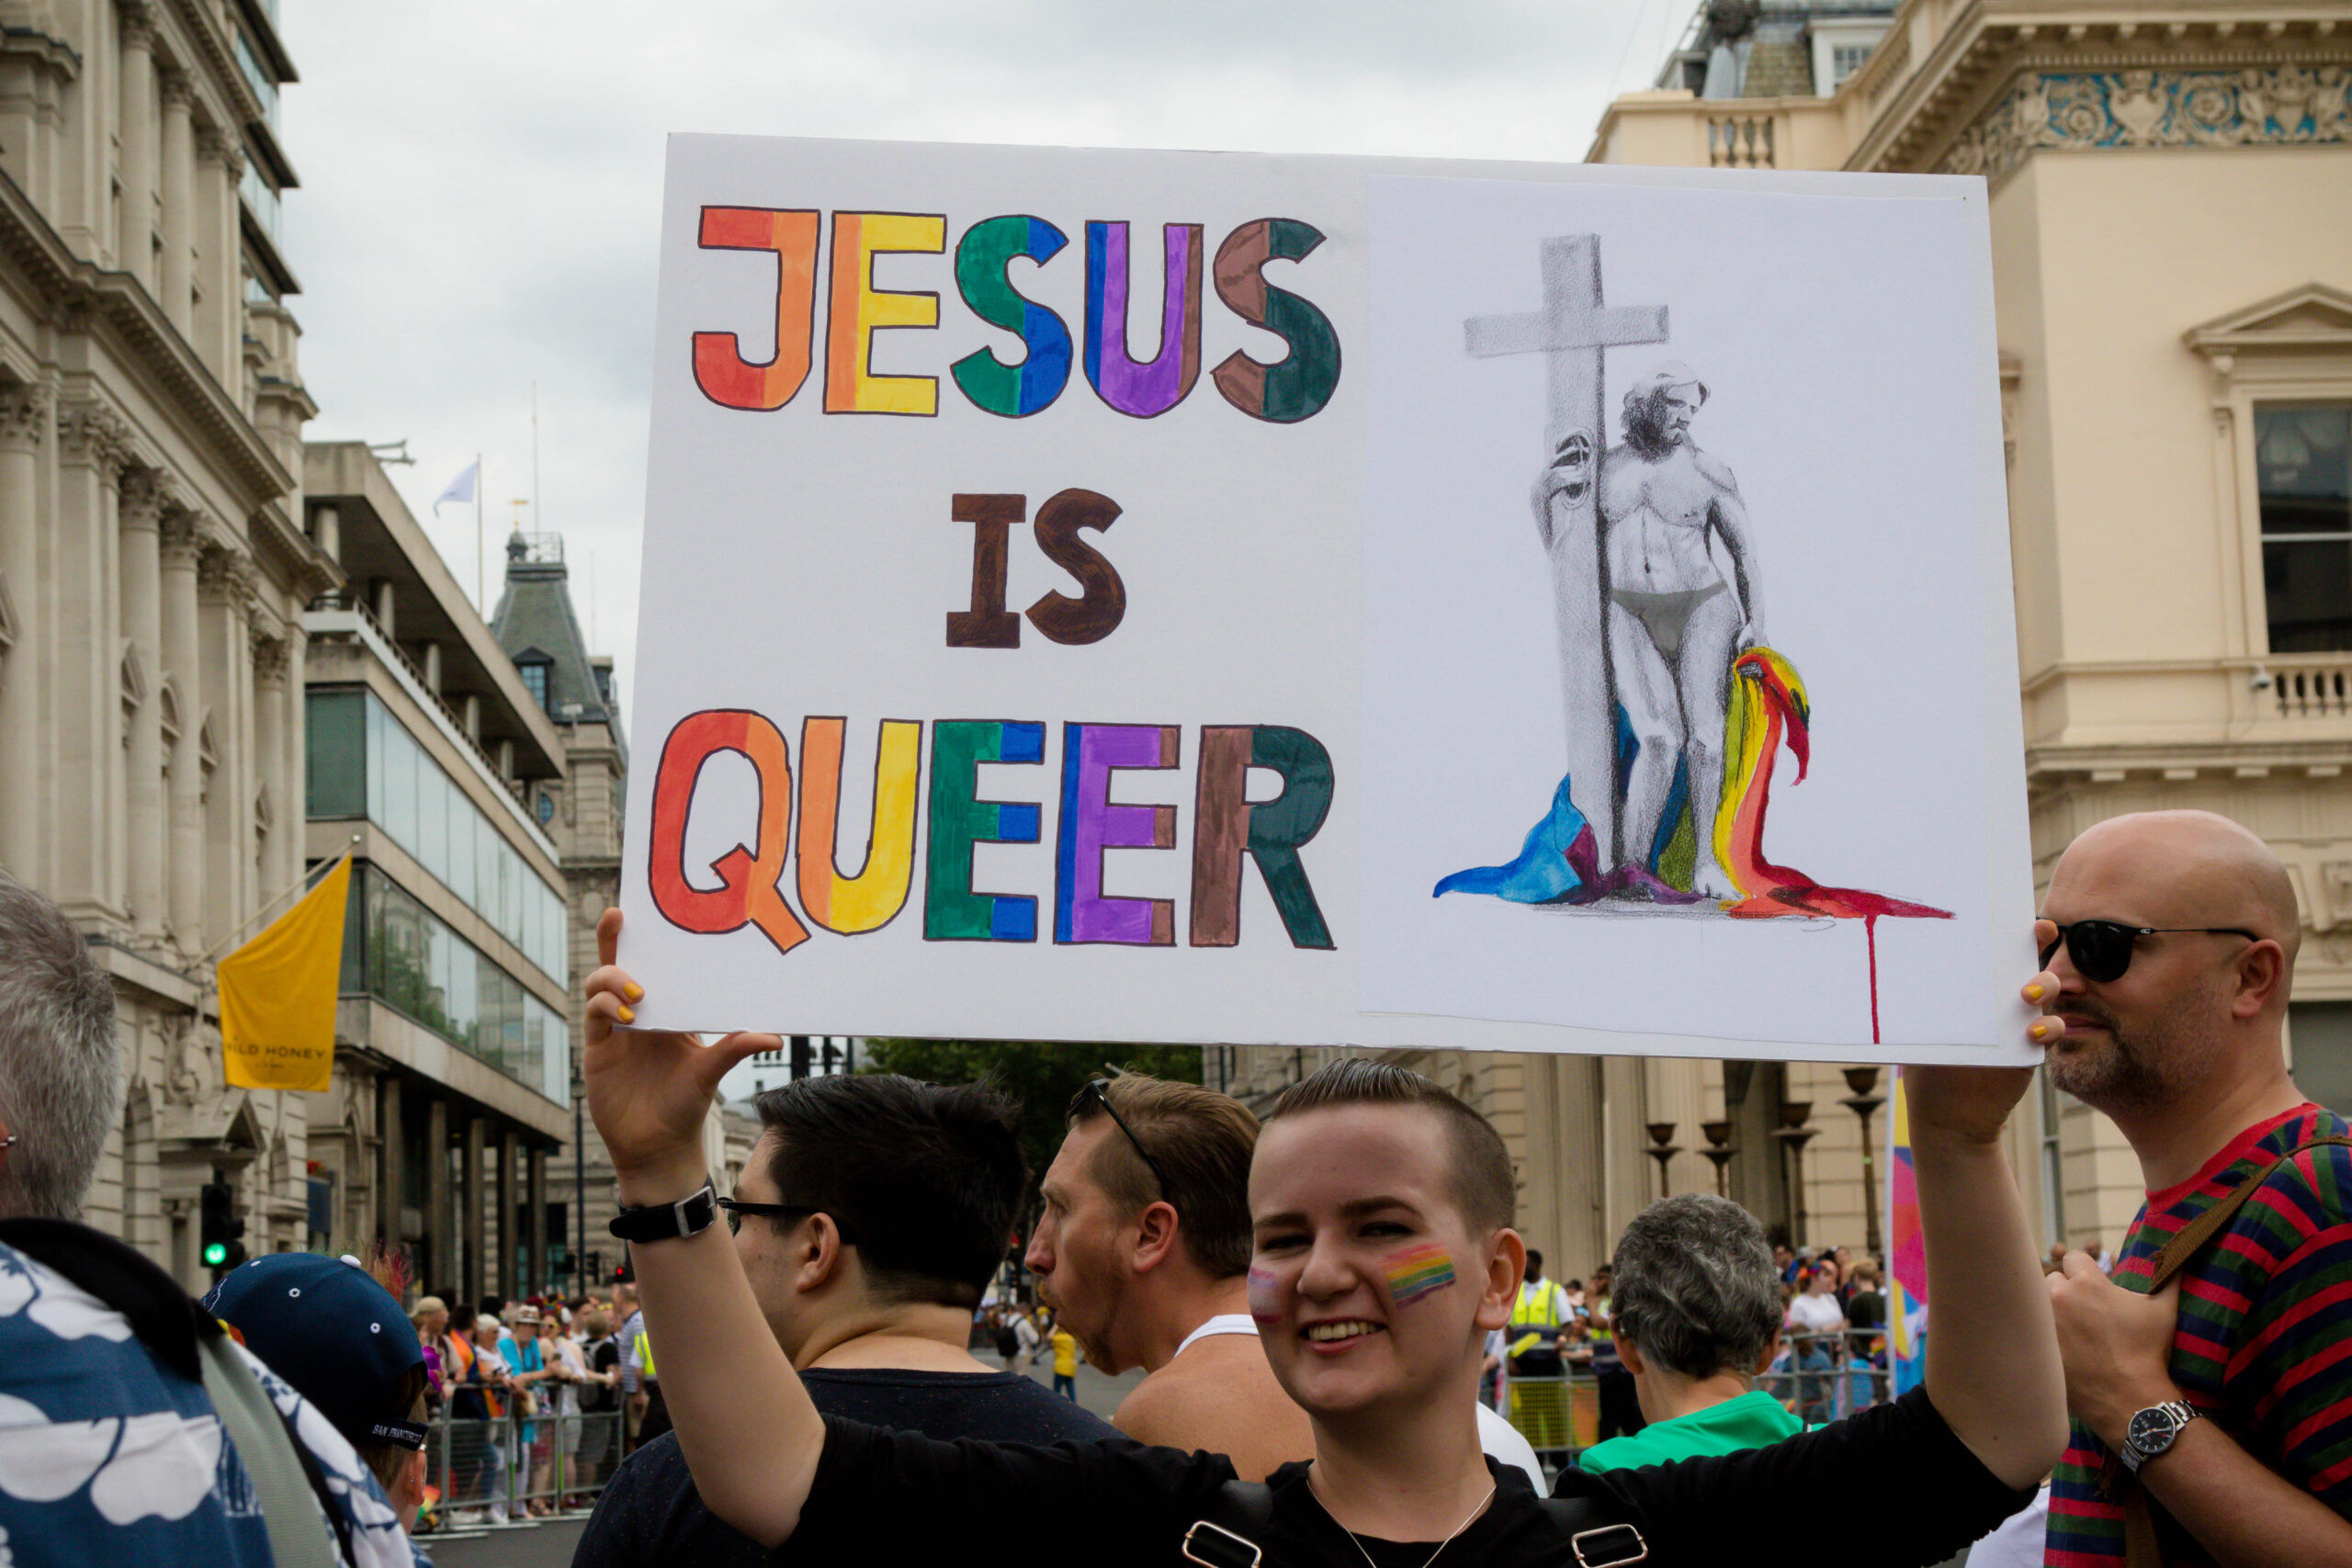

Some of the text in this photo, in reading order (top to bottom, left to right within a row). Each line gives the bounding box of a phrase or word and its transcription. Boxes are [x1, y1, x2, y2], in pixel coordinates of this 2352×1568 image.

[691, 205, 1342, 423] JESUS
[945, 488, 1127, 649] IS
[648, 708, 1338, 954] QUEER
[265, 1045, 326, 1060] HONEY
[371, 1424, 423, 1443] SAN FRANCISCO
